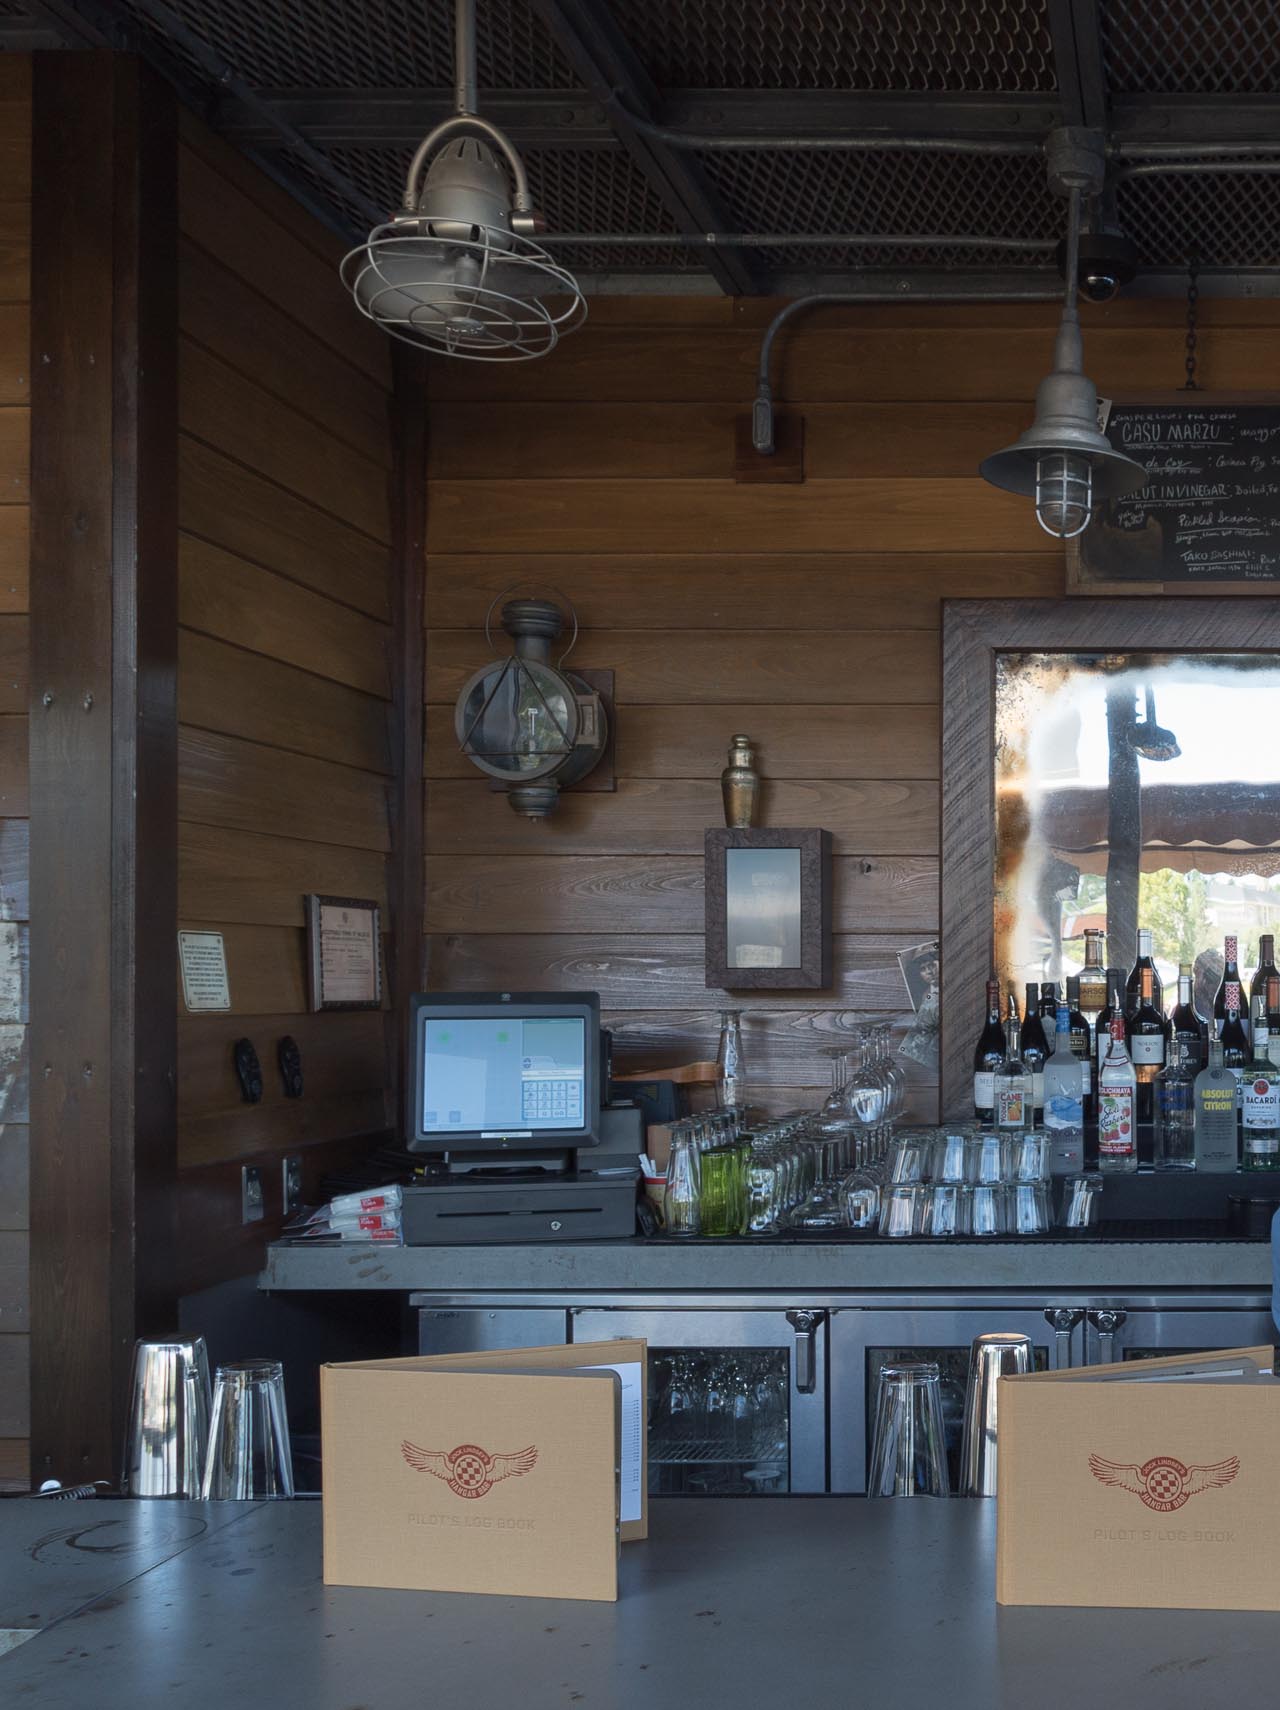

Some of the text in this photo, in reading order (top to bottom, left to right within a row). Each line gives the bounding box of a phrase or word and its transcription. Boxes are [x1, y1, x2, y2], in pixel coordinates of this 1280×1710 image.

[1121, 422, 1162, 442] CASU
[1168, 422, 1221, 441] MARZU
[1179, 550, 1209, 563] TAKO
[1201, 1089, 1234, 1099] ABSOLUT
[1203, 1101, 1232, 1111] CITRON
[450, 1480, 478, 1498] HANGAR
[1141, 1492, 1189, 1511] HANGAR BAR
[407, 1512, 462, 1528] PILOT'S
